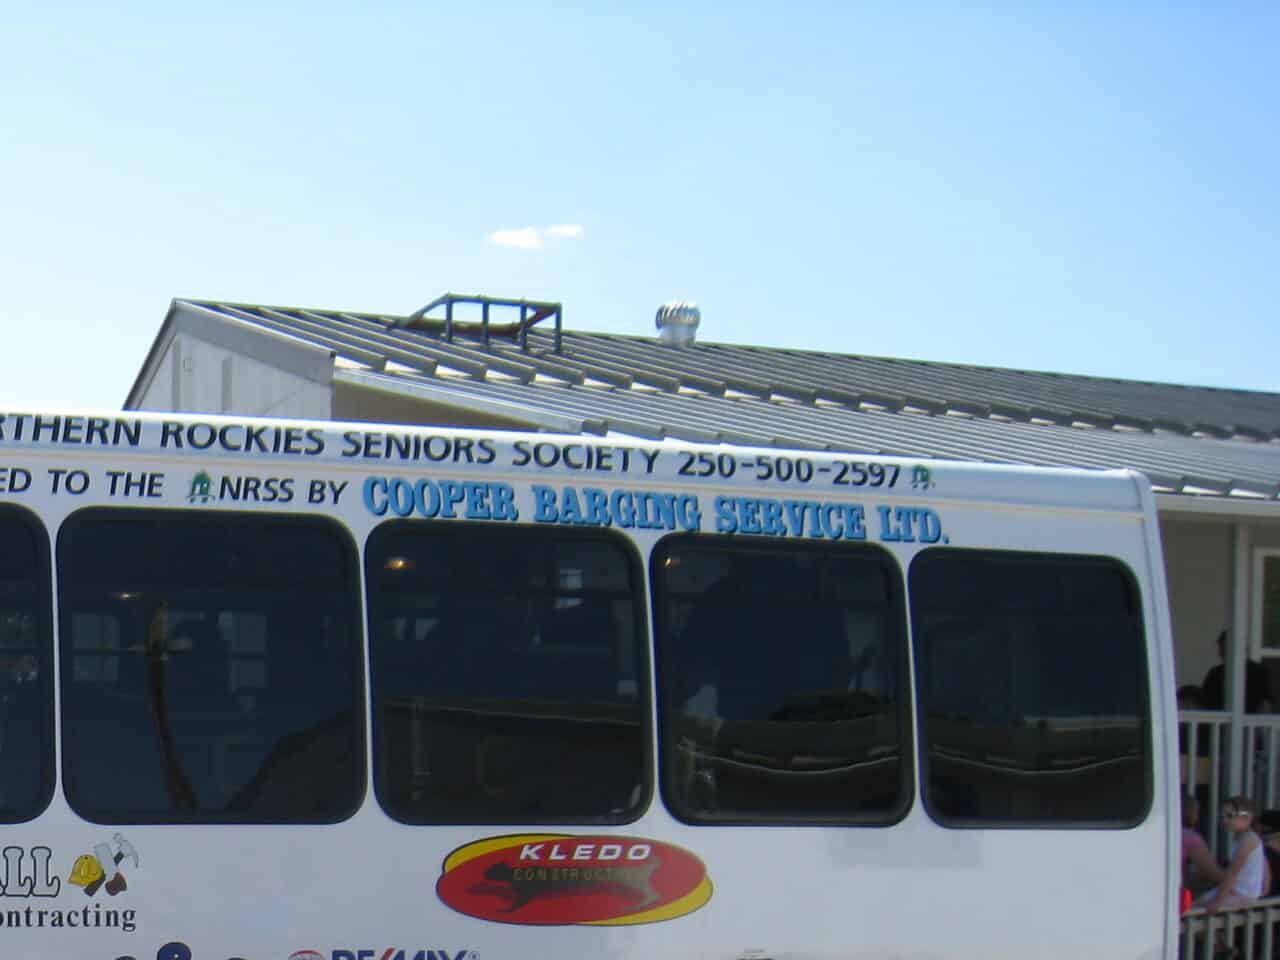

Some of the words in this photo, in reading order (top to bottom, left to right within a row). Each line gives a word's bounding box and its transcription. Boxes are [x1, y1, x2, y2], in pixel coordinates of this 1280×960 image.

[160, 421, 324, 456] ROCKIES
[341, 430, 497, 466] SENIORS
[512, 440, 661, 475] SOCIETY
[677, 450, 901, 489] 250-500-2597
[47, 468, 90, 497] TO
[106, 471, 165, 498] THE
[220, 476, 295, 503] NRSS
[307, 480, 348, 505] BY
[363, 476, 518, 523] COOPER
[533, 485, 700, 533] BARGING
[714, 495, 865, 540] SERVICE
[879, 505, 951, 546] LTD.
[519, 844, 652, 860] KLEDO
